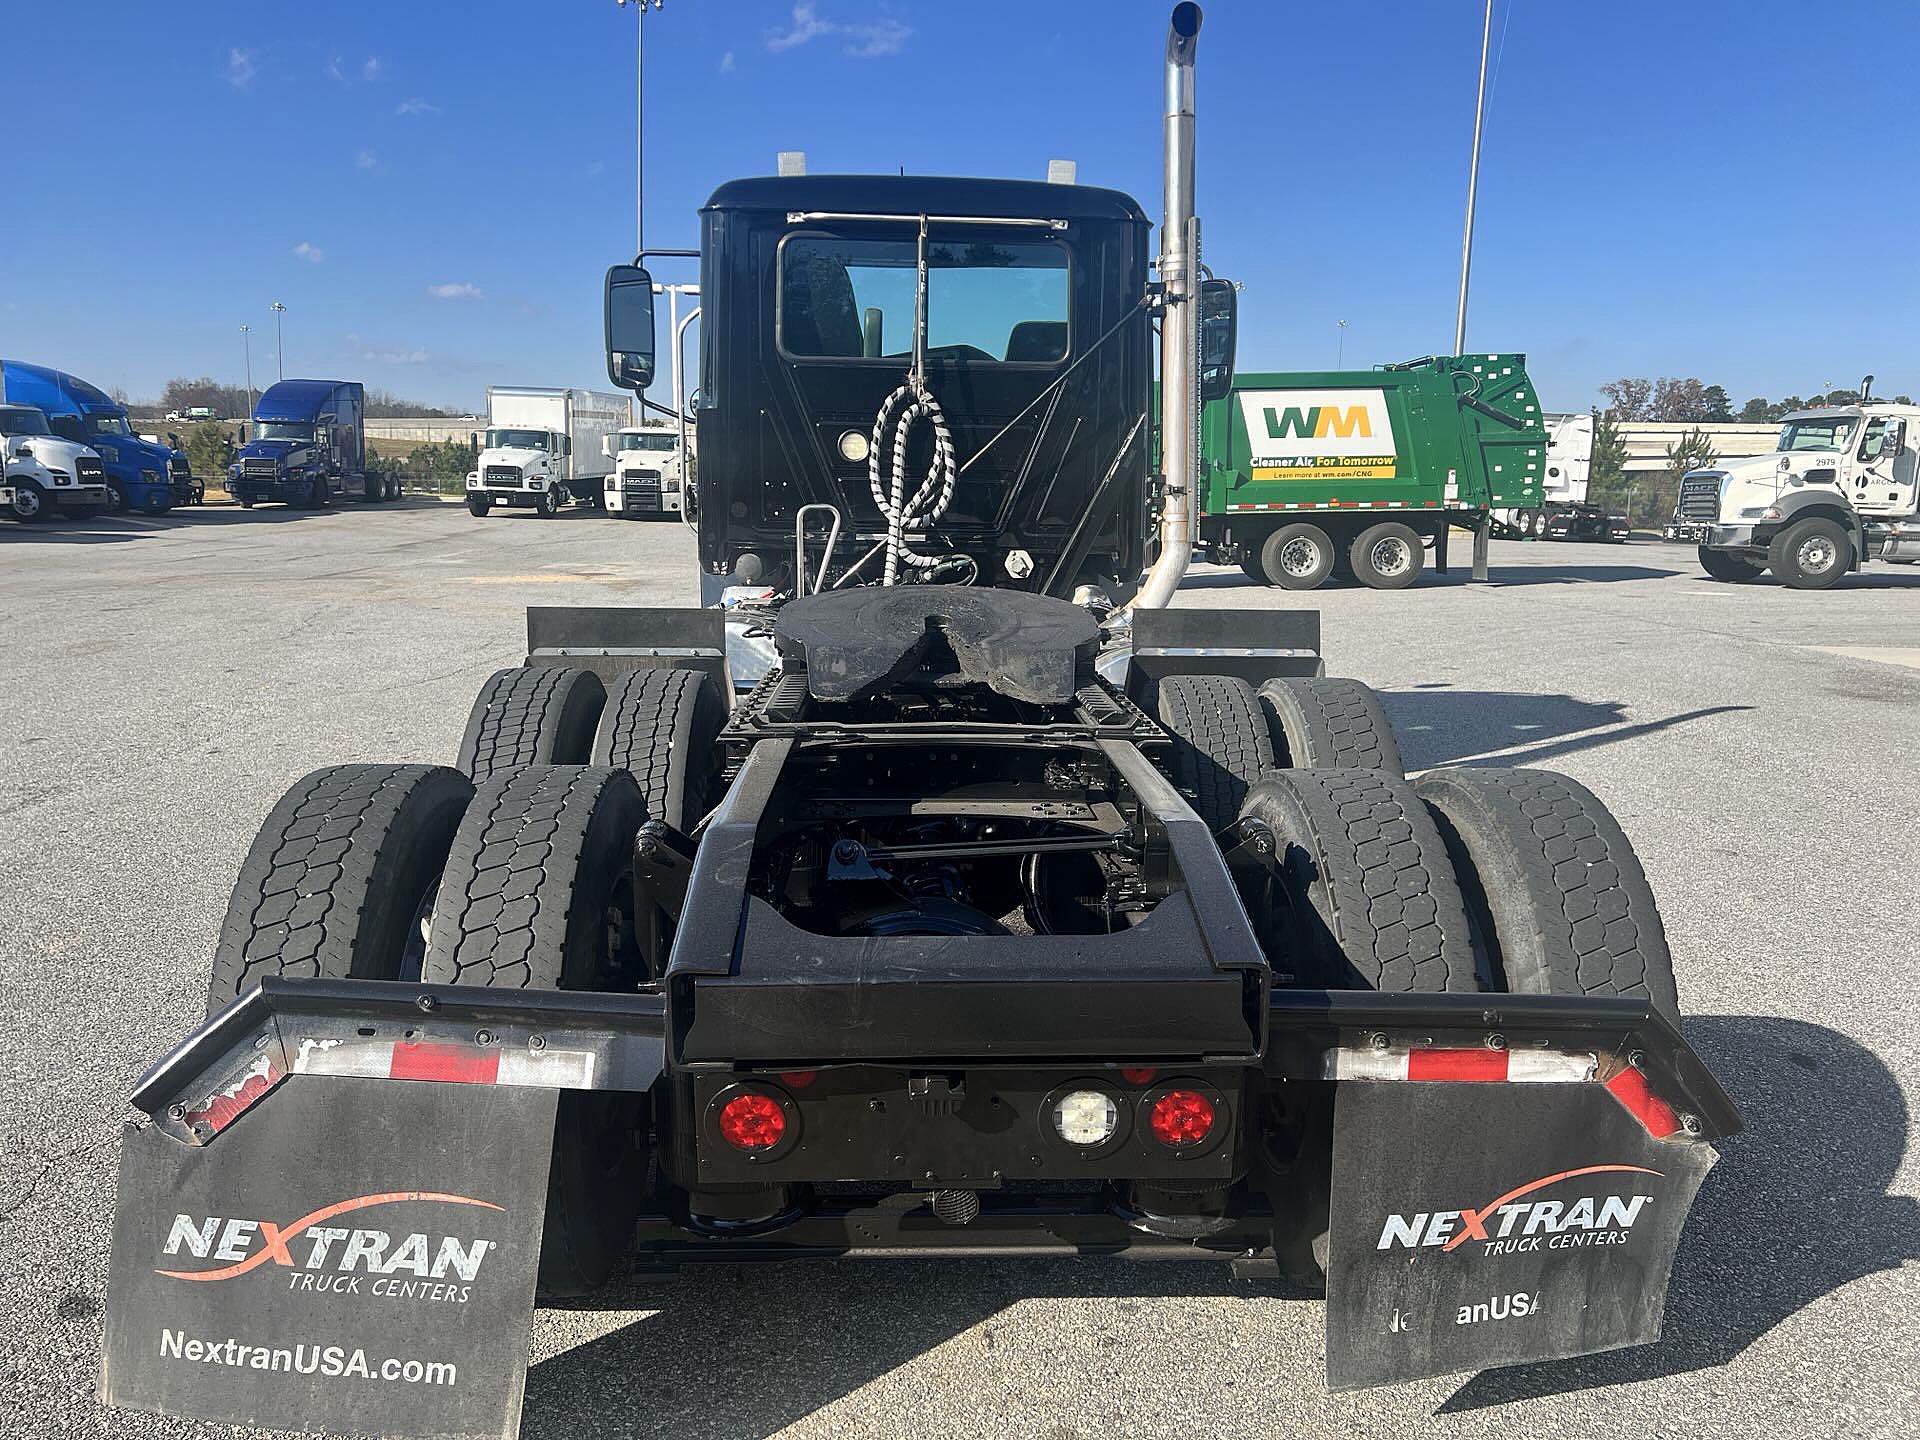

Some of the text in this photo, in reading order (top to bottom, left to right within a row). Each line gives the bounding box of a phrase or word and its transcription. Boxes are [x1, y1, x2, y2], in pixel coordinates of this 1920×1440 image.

[1263, 406, 1372, 438] WM
[1250, 456, 1393, 468] Cleaner Air, For Tomorrow
[1816, 458, 1835, 466] 2979
[1377, 1196, 1647, 1250] NEXTRAN
[163, 1214, 489, 1281] NEXTRAN
[1484, 1231, 1630, 1257] TRUCK CENTERS
[289, 1272, 472, 1303] TRUCK CENTERS
[159, 1328, 457, 1386] NextranUSA.com
